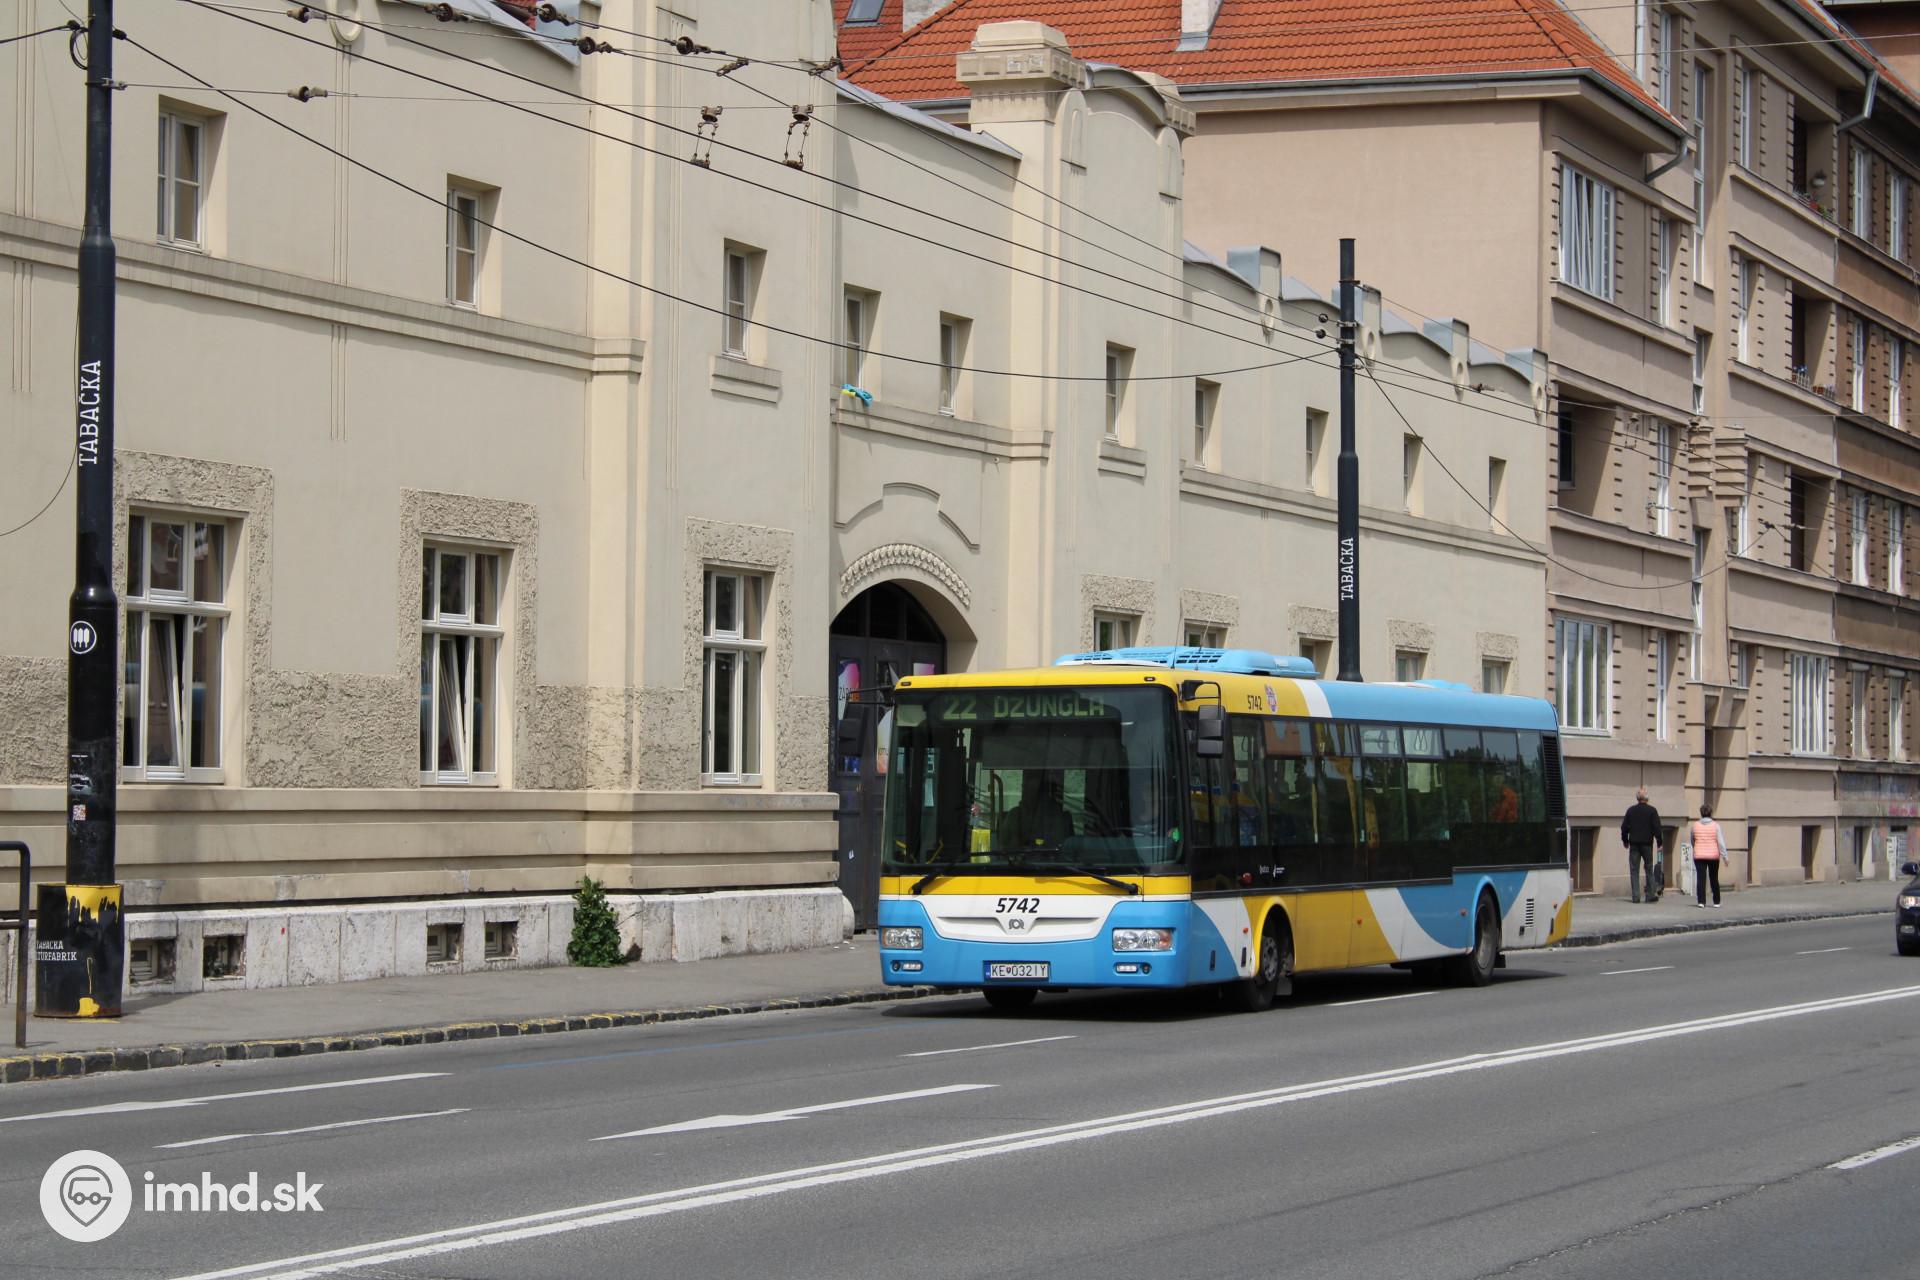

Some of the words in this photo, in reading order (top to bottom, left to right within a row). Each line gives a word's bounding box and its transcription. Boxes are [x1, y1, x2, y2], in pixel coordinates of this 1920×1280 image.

[78, 360, 101, 466] TABAČKA
[1340, 538, 1354, 601] TABAČKA
[943, 694, 977, 720] 22
[1247, 695, 1262, 711] 5742
[996, 897, 1040, 914] 5742
